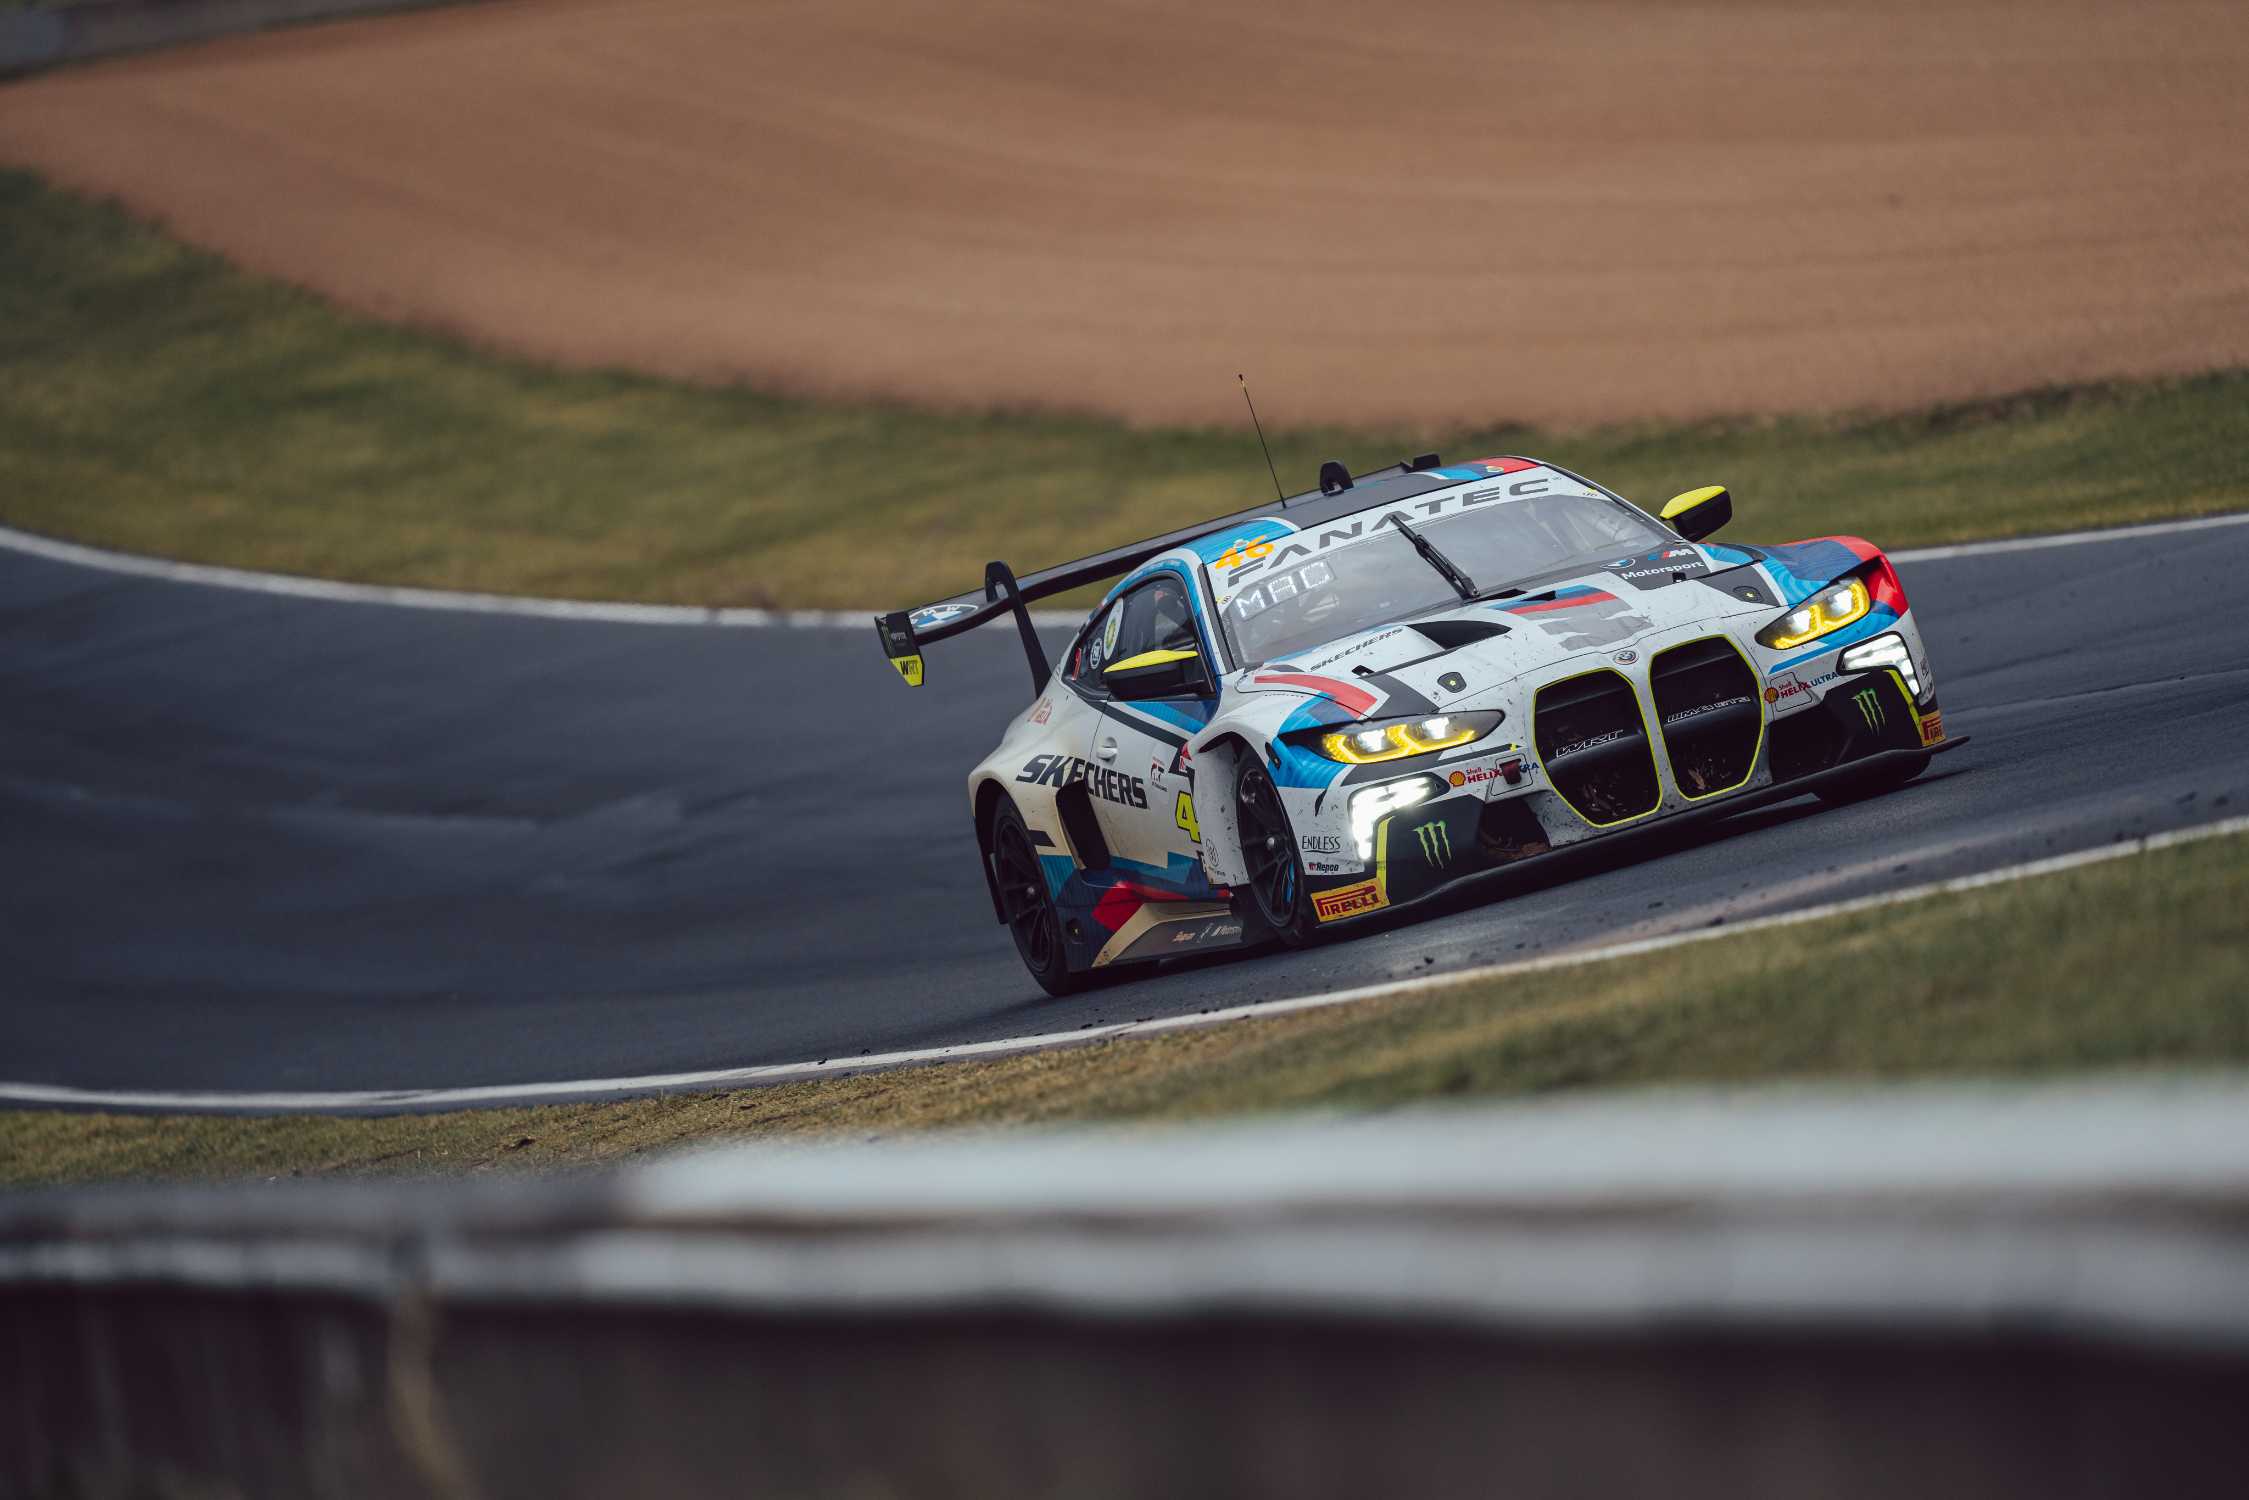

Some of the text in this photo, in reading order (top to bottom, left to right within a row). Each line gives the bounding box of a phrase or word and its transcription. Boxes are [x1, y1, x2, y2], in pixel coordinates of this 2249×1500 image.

[1227, 478, 1549, 588] FANATEC
[1214, 535, 1275, 569] 46
[1621, 561, 1705, 580] Motorsport
[1310, 628, 1403, 672] SKECHERS
[1780, 671, 1839, 699] HELIX ULTRA
[1016, 754, 1149, 810] SKECHERS
[1465, 766, 1482, 775] Shell
[1467, 768, 1503, 784] HELIX
[1301, 835, 1341, 850] ENDLESS
[1315, 861, 1340, 873] Repco
[1315, 885, 1380, 917] PIRELLI
